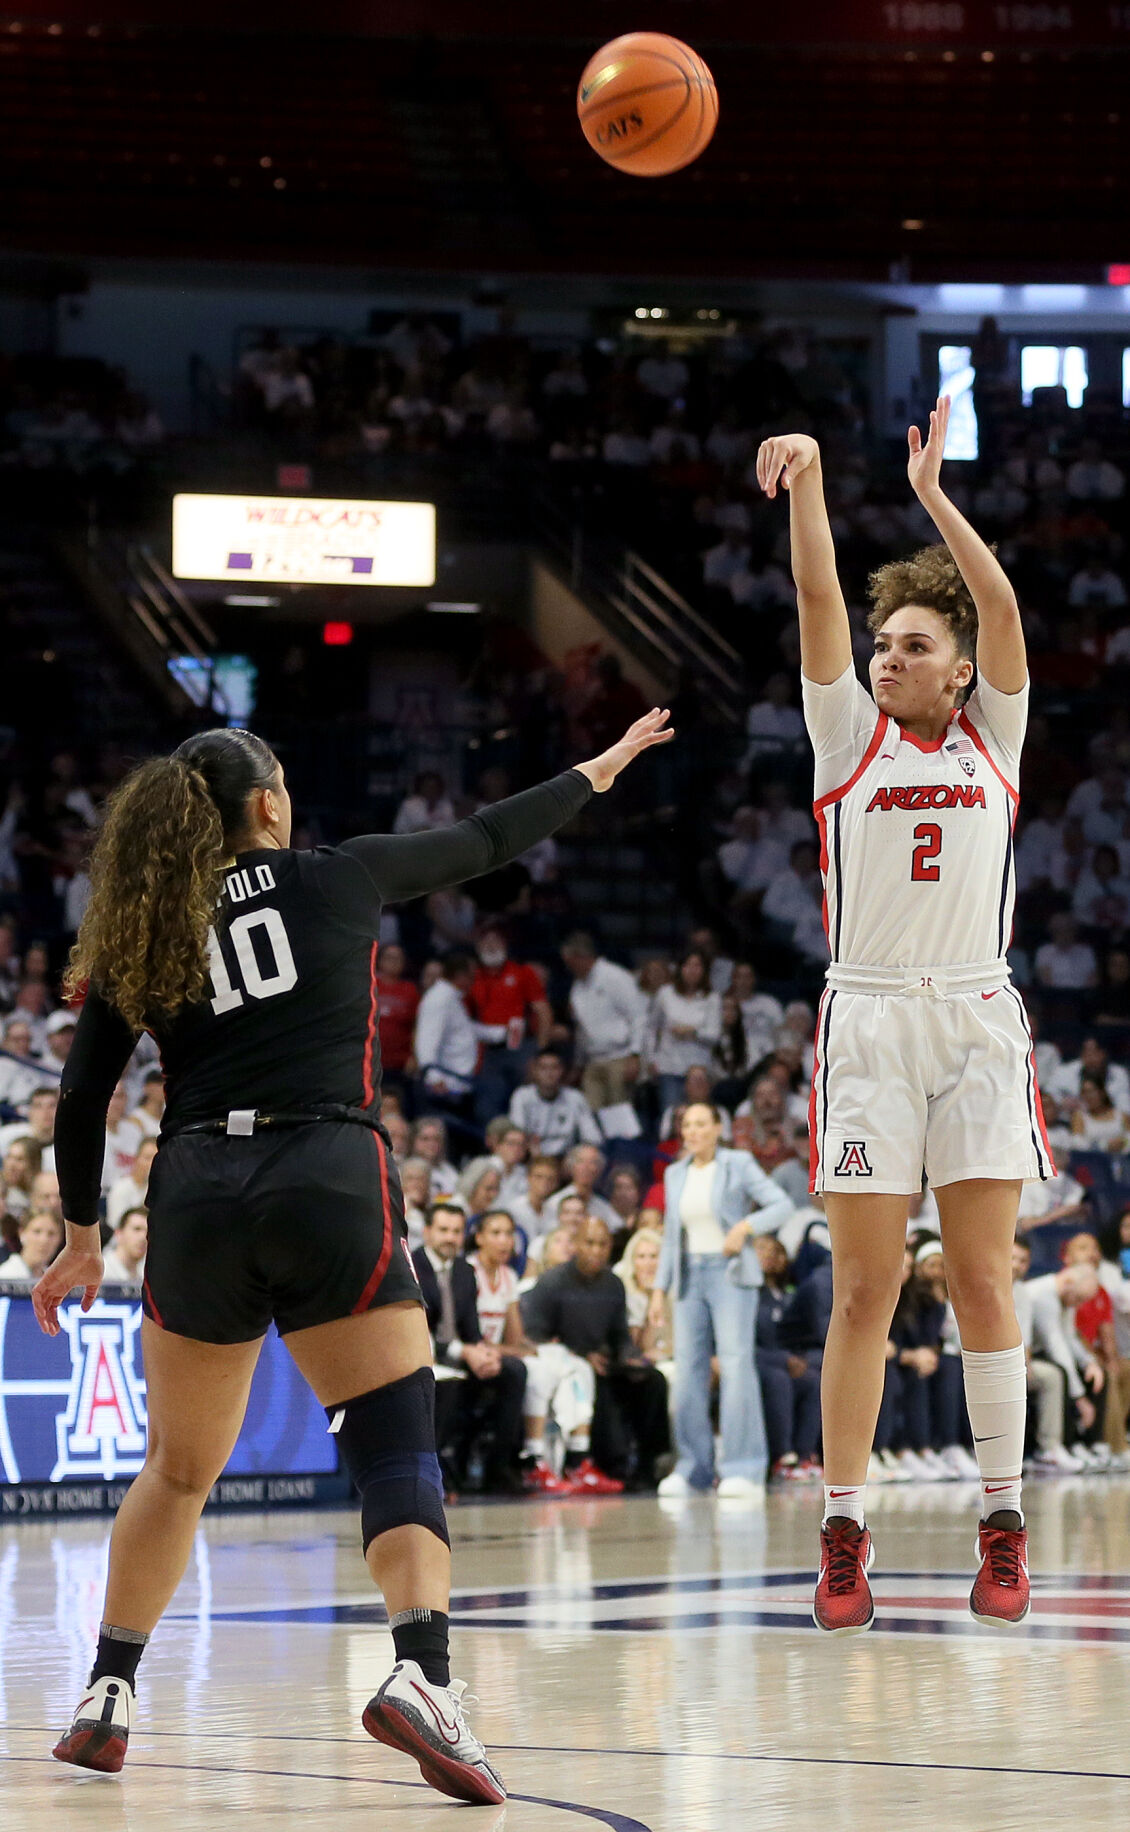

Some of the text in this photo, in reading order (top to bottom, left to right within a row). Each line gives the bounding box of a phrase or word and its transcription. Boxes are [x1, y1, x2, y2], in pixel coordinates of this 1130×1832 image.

[246, 505, 383, 529] WILDCATS
[865, 785, 987, 812] ARIZONA
[910, 822, 942, 882] 2
[216, 864, 277, 908] OLO
[207, 906, 299, 1015] 10
[834, 1140, 872, 1177] A
[62, 1309, 147, 1464] A
[56, 1487, 102, 1511] HOME
